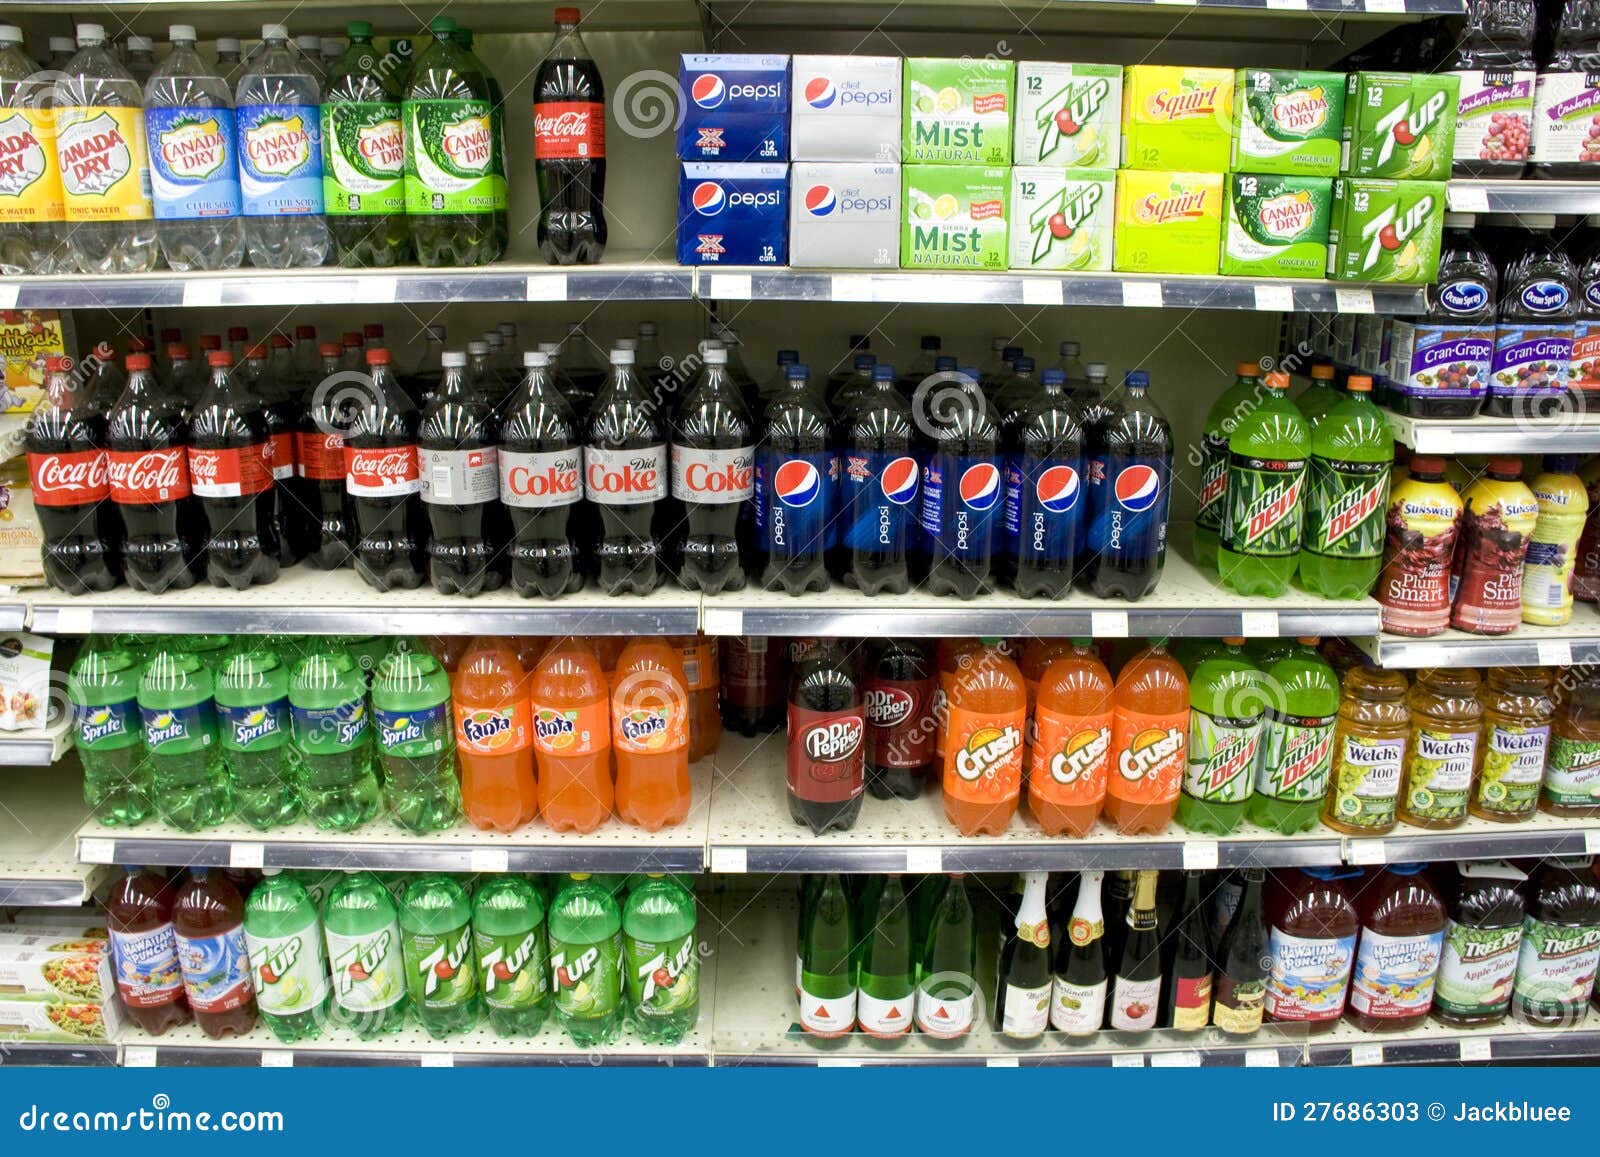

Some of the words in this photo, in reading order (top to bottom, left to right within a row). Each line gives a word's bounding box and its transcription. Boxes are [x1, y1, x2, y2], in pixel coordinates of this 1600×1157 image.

[840, 80, 860, 90] diet
[1026, 76, 1042, 90] 12
[1252, 72, 1271, 88] 12
[729, 82, 781, 101] pepsi
[840, 89, 892, 107] pepsi
[1367, 87, 1383, 102] 12
[1152, 85, 1217, 120] Squirt
[1273, 97, 1328, 121] CANADA
[1289, 112, 1315, 128] DRY
[60, 129, 125, 173] CANADA
[162, 131, 226, 164] CANADA
[247, 129, 310, 161] CANADA
[760, 149, 778, 157] cans
[763, 140, 775, 150] 12
[914, 149, 981, 161] NATURAL
[991, 147, 1001, 156] 12
[1141, 148, 1159, 162] 12
[0, 154, 24, 178] RY
[73, 152, 111, 181] DRY
[182, 150, 215, 170] DRY
[265, 146, 298, 168] DRY
[840, 188, 860, 197] diet
[1020, 182, 1036, 195] 12
[1239, 176, 1257, 191] 12
[729, 190, 780, 208] pepsi
[840, 196, 892, 214] pepsi
[1141, 189, 1207, 223] Squirt
[1353, 192, 1369, 206] 12
[1259, 201, 1314, 225] CANADA
[1275, 216, 1302, 232] DRY
[759, 254, 777, 263] cans
[762, 246, 774, 256] 12
[913, 253, 980, 265] NATURAL
[988, 252, 999, 261] 12
[1131, 252, 1148, 264] 12
[1445, 290, 1464, 305] Ocean
[1463, 291, 1481, 308] Spray
[1525, 290, 1544, 304] Ocean
[1543, 291, 1562, 307] Spray
[108, 450, 180, 491] ca-Cola
[351, 451, 411, 478] Coca-Cola
[554, 458, 578, 473] Diet
[630, 457, 657, 471] Diet
[508, 467, 578, 497] Coke
[588, 463, 657, 493] Coke
[685, 463, 753, 493] Coke
[772, 506, 785, 546] pepsi
[878, 505, 891, 545] pepsi
[956, 511, 969, 550] pepsi
[1032, 512, 1045, 551] pepsi
[1110, 510, 1122, 550] pepsi
[1388, 579, 1444, 602] Smart
[1402, 573, 1439, 589] Plum
[864, 691, 909, 722] Pepper
[82, 718, 120, 741] Sprite
[148, 722, 183, 745] Sprite
[236, 718, 275, 743] Sprite
[382, 723, 420, 746] Sprite
[463, 715, 511, 742] Fanta
[534, 715, 573, 738] Fanta
[622, 714, 666, 741] Fanta
[813, 726, 862, 758] Pepper
[1421, 738, 1470, 756] Welch's
[1495, 733, 1544, 751] Welch's
[955, 724, 1021, 782] Crush
[1051, 725, 1112, 784] Crush
[1119, 725, 1184, 783] Crush
[1349, 744, 1398, 762] Welch's
[985, 752, 1014, 780] Orange
[1147, 752, 1178, 781] Orange
[131, 941, 169, 964] PUNCH
[1279, 944, 1337, 960] HAWAIIAN
[1372, 941, 1429, 959] HAWAIIAN
[1465, 940, 1500, 959] TREE
[1544, 937, 1580, 956] TREE
[1283, 954, 1327, 971] PUNCH
[1379, 951, 1419, 970] PUNCH
[1463, 966, 1492, 982] Apple
[1494, 957, 1516, 974] Juice
[1541, 962, 1570, 978] Apple
[1571, 956, 1597, 971] Juice
